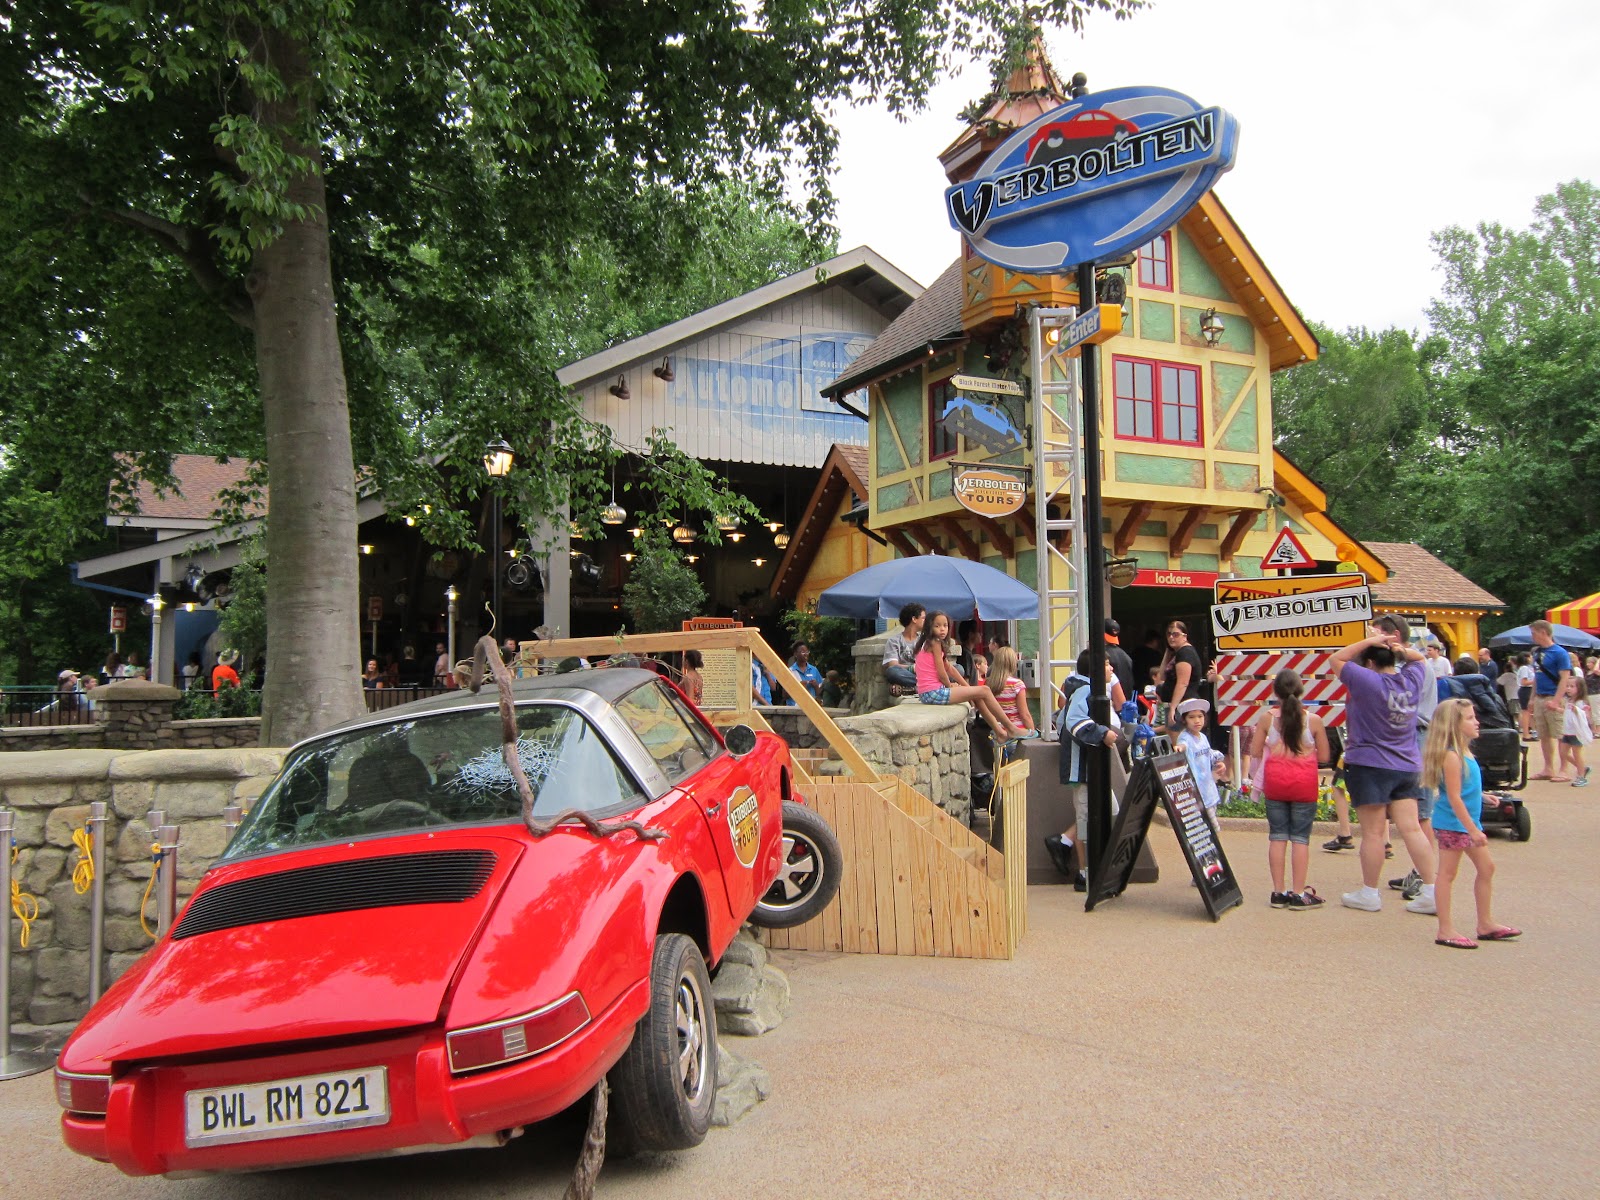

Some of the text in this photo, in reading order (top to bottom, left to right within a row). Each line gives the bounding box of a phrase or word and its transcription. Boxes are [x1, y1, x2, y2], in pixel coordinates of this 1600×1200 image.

[949, 111, 1216, 236] VERBOLTEN
[1069, 314, 1099, 341] Enter
[954, 477, 1026, 493] VERBOLTEN
[967, 494, 1014, 505] TOURS
[1155, 572, 1191, 585] lockers
[1213, 592, 1369, 633] VERBOLTEN
[738, 823, 758, 850] TOURS
[203, 1076, 370, 1131] BWL RM 821
